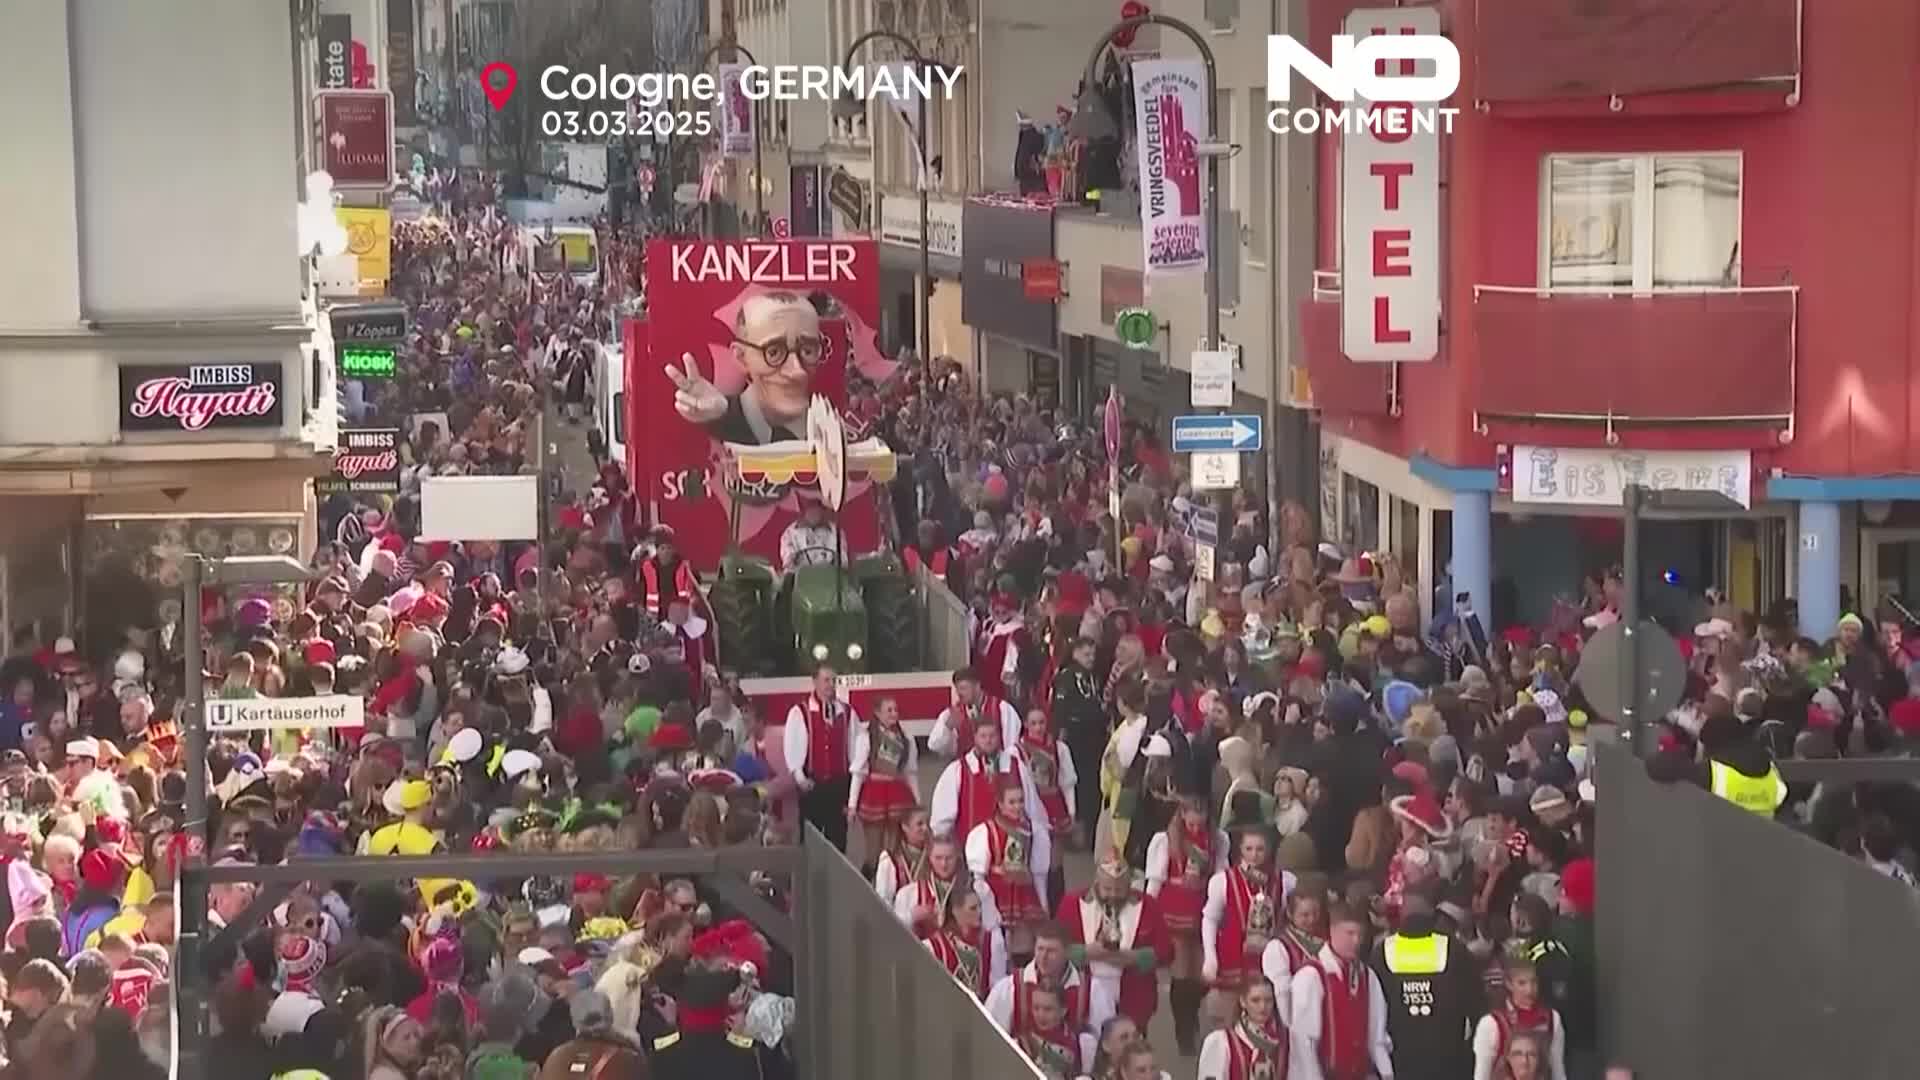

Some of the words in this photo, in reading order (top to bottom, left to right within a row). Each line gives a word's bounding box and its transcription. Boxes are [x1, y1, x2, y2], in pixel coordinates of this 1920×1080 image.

[1144, 95, 1165, 218] VRINGSVEEDEL
[671, 244, 857, 282] KANZLER
[344, 355, 394, 370] KIOSK
[193, 366, 250, 384] IMBISS
[130, 377, 276, 431] Hayati
[348, 434, 394, 446] IMBISS
[237, 703, 347, 721] Kartäuserhof
[1402, 980, 1431, 993] NRW
